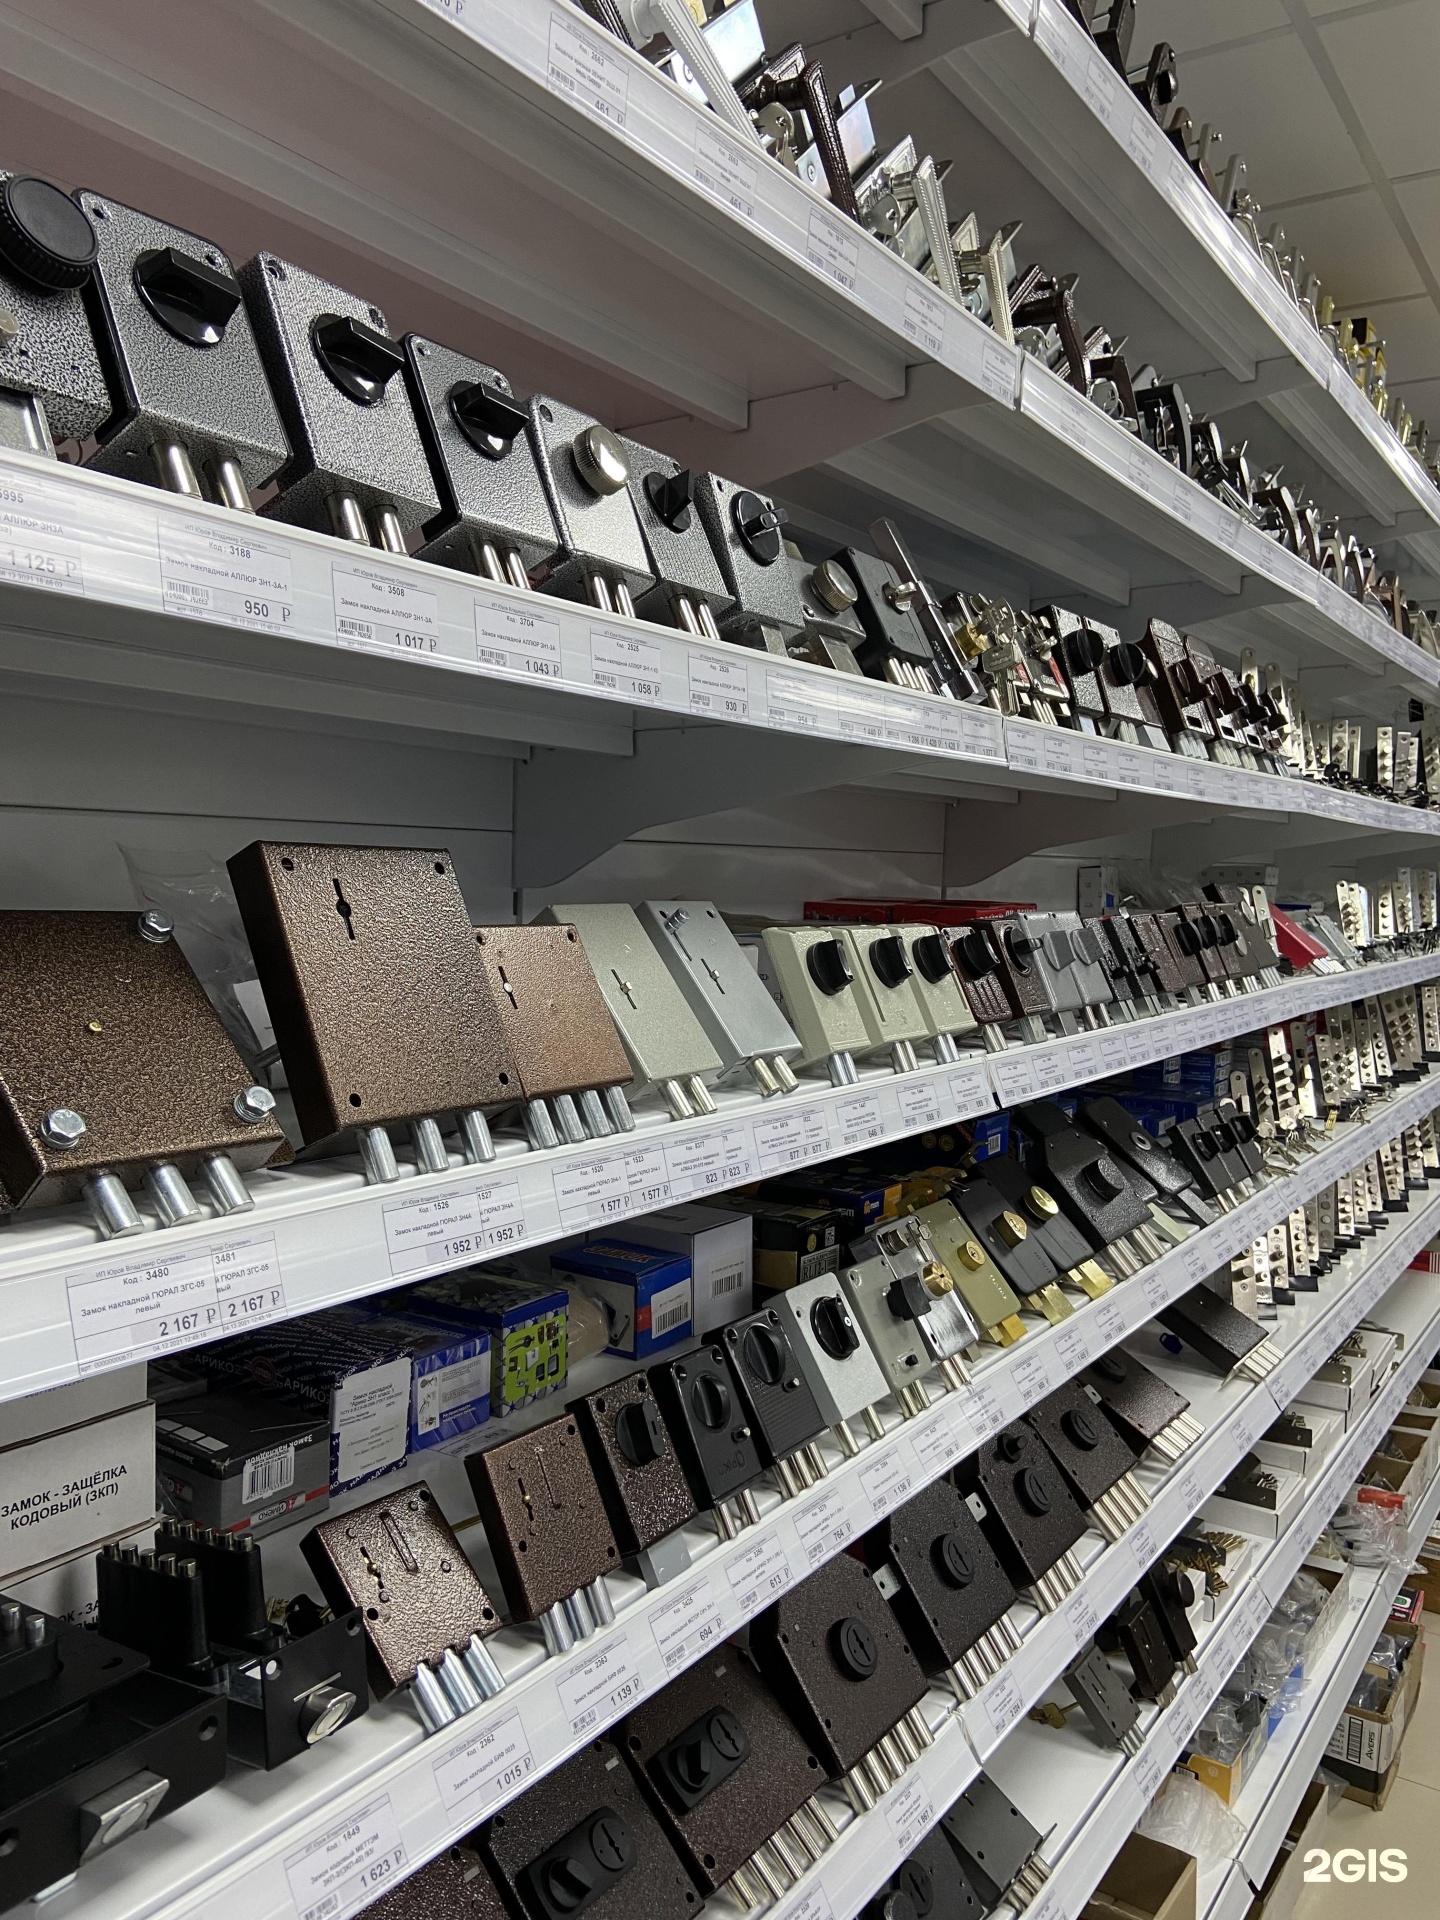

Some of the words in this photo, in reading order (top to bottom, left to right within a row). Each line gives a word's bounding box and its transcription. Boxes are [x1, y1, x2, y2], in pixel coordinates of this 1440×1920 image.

[595, 98, 608, 116] 461
[229, 545, 250, 558] 3188
[8, 548, 15, 565] 1
[25, 552, 55, 573] 125
[190, 562, 228, 578] накладной
[230, 571, 256, 583] АЛЛЮР
[387, 584, 404, 597] 3508
[244, 599, 268, 617] 950
[340, 597, 358, 607] Замок
[359, 601, 390, 614] накладной
[519, 617, 533, 627] 3704
[395, 632, 400, 644] 1
[404, 634, 423, 649] 017
[481, 629, 495, 637] Замок
[497, 632, 521, 644] накладной
[525, 659, 529, 670] 1
[533, 660, 549, 674] 043
[632, 681, 635, 691] 1
[638, 682, 651, 695] 058
[725, 700, 736, 711] 930
[632, 1155, 644, 1163] 1523
[591, 1164, 604, 1173] 1520
[728, 1165, 740, 1177] 823
[705, 1172, 717, 1184] 823
[477, 1190, 492, 1200] 1527
[561, 1187, 574, 1195] Замок
[641, 1191, 646, 1201] 1
[647, 1187, 660, 1200] 577
[433, 1200, 449, 1210] 1526
[483, 1205, 500, 1214] ГЮРАЛ
[600, 1202, 605, 1213] 1
[606, 1198, 621, 1211] 577
[394, 1226, 411, 1236] Замок
[412, 1220, 439, 1232] накладной
[439, 1216, 457, 1225] ГЮРАЛ
[427, 1228, 443, 1236] левый
[488, 1232, 493, 1243] 1
[496, 1227, 513, 1242] 952
[444, 1244, 449, 1256] 1
[452, 1238, 471, 1254] 952
[214, 1251, 235, 1264] 3481
[95, 1270, 106, 1278] ИП
[106, 1266, 125, 1277] Юров
[125, 1259, 155, 1273] Владимир
[122, 1275, 138, 1286] Код
[145, 1266, 169, 1280] 3480
[220, 1269, 245, 1282] ГЮРАЛ
[80, 1303, 106, 1317] Замок
[107, 1292, 150, 1311] накладной
[151, 1286, 178, 1299] ГЮРАЛ
[135, 1300, 161, 1314] левый
[228, 1302, 236, 1317] 2
[240, 1295, 264, 1313] 167
[158, 1321, 168, 1336] 2
[173, 1312, 199, 1332] 167
[194, 1354, 234, 1374] АРИКО
[284, 1378, 326, 1402] АРИКО
[1, 1490, 50, 1518] ЗАМОК
[62, 1464, 128, 1496] ЗАЩЁЛКА
[11, 1493, 82, 1530] КОДОВЫЙ
[85, 1482, 120, 1506] (ЗКП)
[833, 1527, 844, 1542] 764
[769, 1573, 781, 1589] 613
[699, 1624, 712, 1642] 694
[594, 1654, 608, 1669] 2363
[610, 1695, 616, 1706] 1
[616, 1684, 632, 1702] 139
[479, 1733, 494, 1749] 2362
[1366, 1732, 1375, 1760] AVERS
[452, 1776, 468, 1791] Замок
[468, 1759, 494, 1780] накладной
[496, 1778, 502, 1791] 1
[503, 1764, 522, 1785] 015
[342, 1824, 360, 1842] 1849
[310, 1867, 329, 1884] Замок
[328, 1850, 355, 1871] кодовый
[359, 1874, 367, 1888] 1
[368, 1858, 392, 1882] 623
